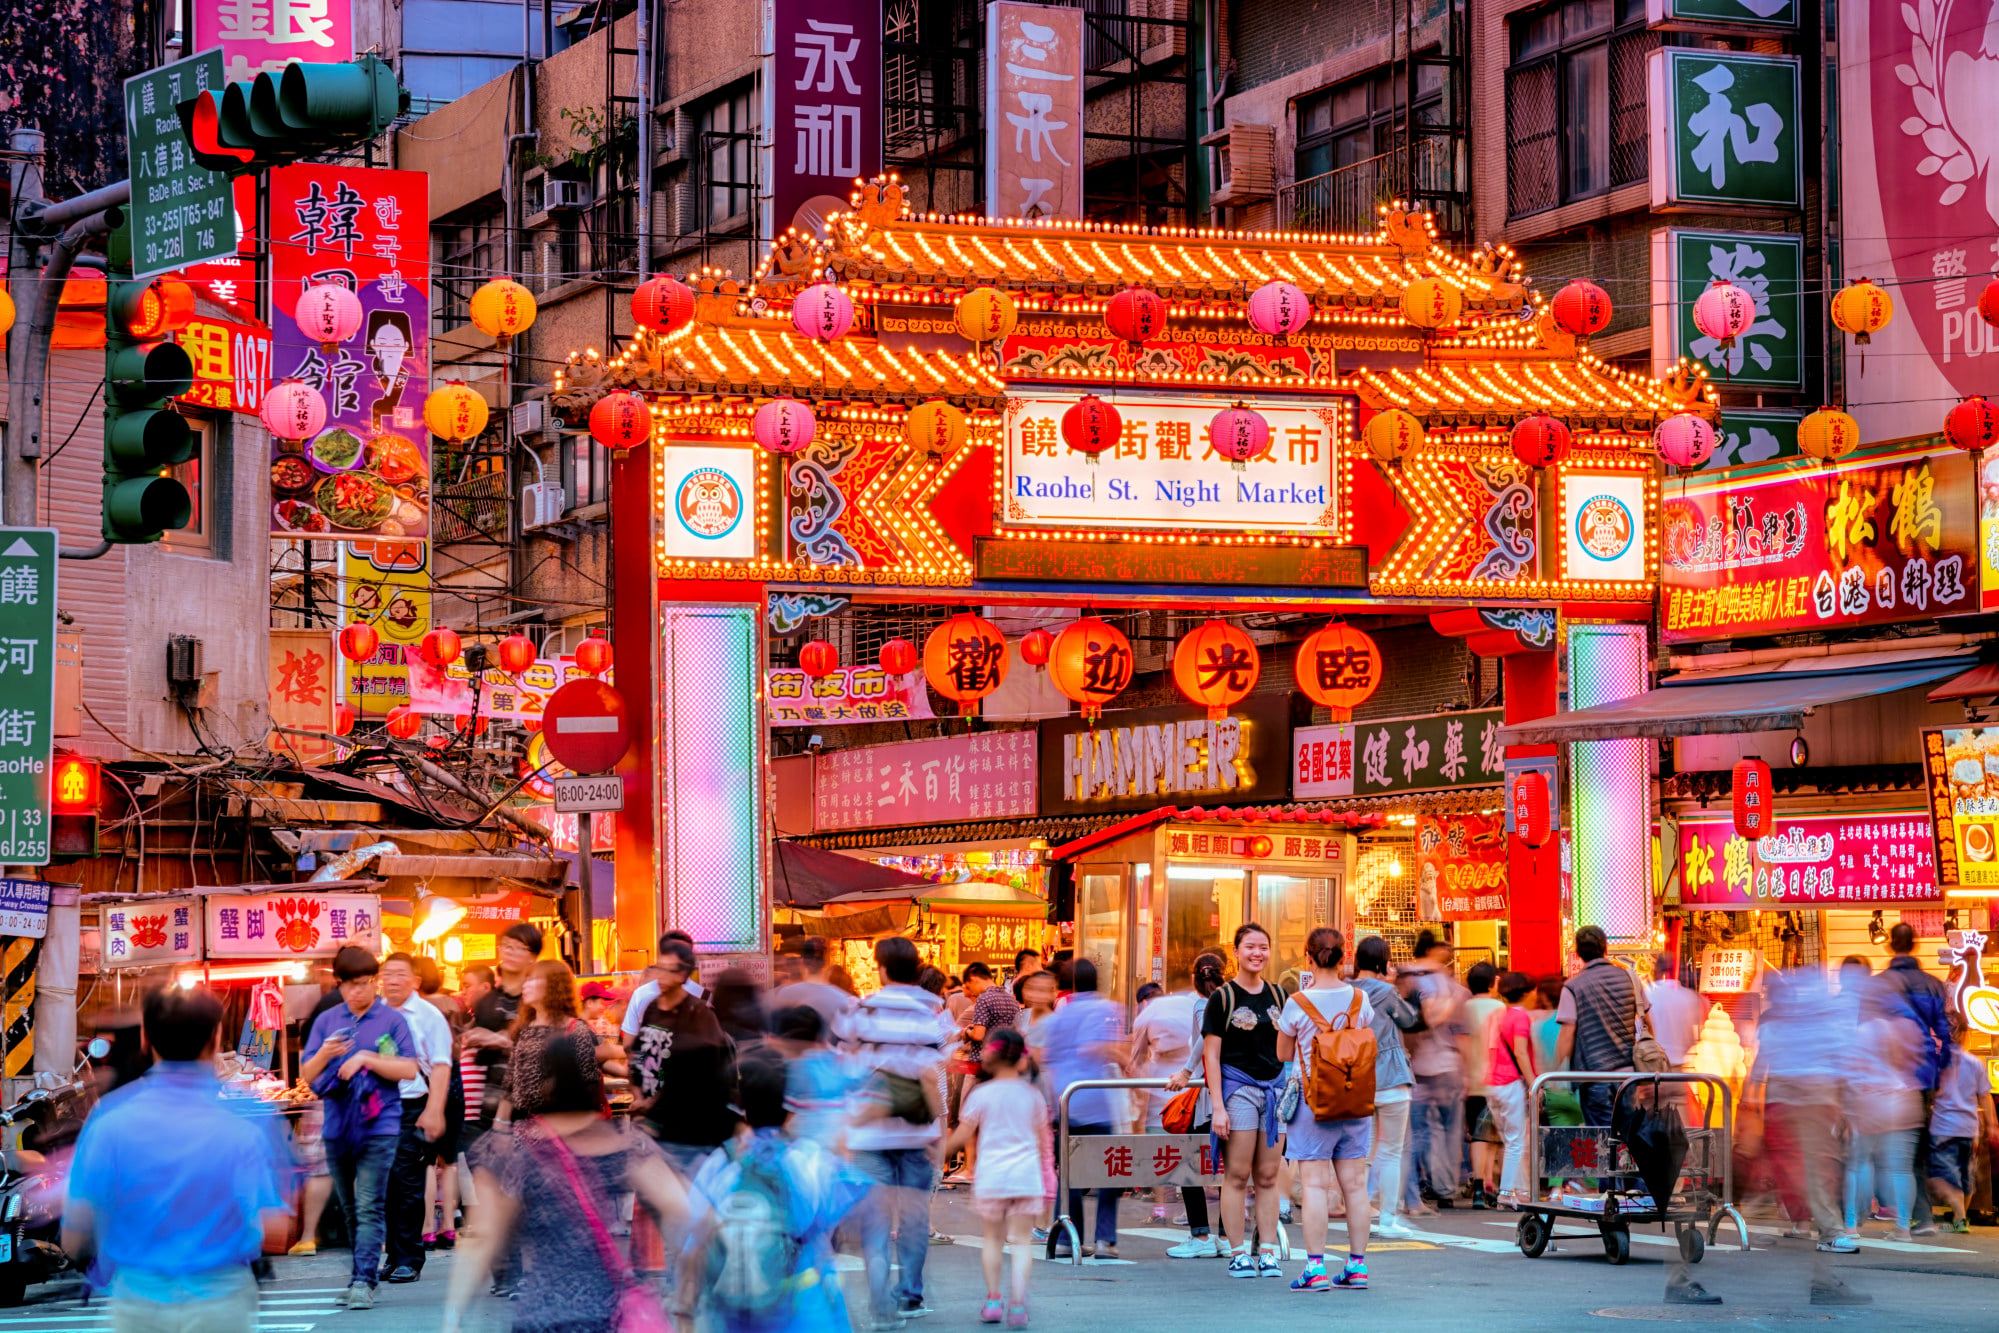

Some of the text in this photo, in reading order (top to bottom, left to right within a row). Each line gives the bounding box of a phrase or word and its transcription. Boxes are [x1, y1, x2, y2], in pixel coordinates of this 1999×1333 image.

[141, 63, 209, 115] 饒河街
[795, 19, 861, 178] 永和
[149, 184, 169, 203] BaDe
[172, 180, 185, 197] Rd.
[188, 175, 206, 193] Sec.
[145, 210, 180, 237] 33-255
[183, 197, 225, 227] 765-847
[146, 236, 181, 264] 30-226
[197, 228, 215, 251] 746
[373, 196, 404, 303] 한국관
[291, 181, 366, 418] 韓館
[1016, 474, 1326, 508] Raohe St. Night Market
[1827, 463, 1944, 561] 松鶴
[1812, 555, 1966, 620] 台港日料理
[945, 636, 1371, 695] 歡 迎 光 臨
[1064, 716, 1241, 801] HAMMER
[1299, 739, 1352, 784] 各國名藥
[557, 784, 619, 802] 16:00-24:00
[878, 754, 966, 807] 三禾百貨
[1022, 781, 1033, 814] 百貨
[1171, 832, 1342, 860] 媽祖廟口 服務台
[1685, 831, 1755, 898] 松鶴
[1757, 866, 1835, 899] 台港日料理
[20, 901, 48, 913] Crossing
